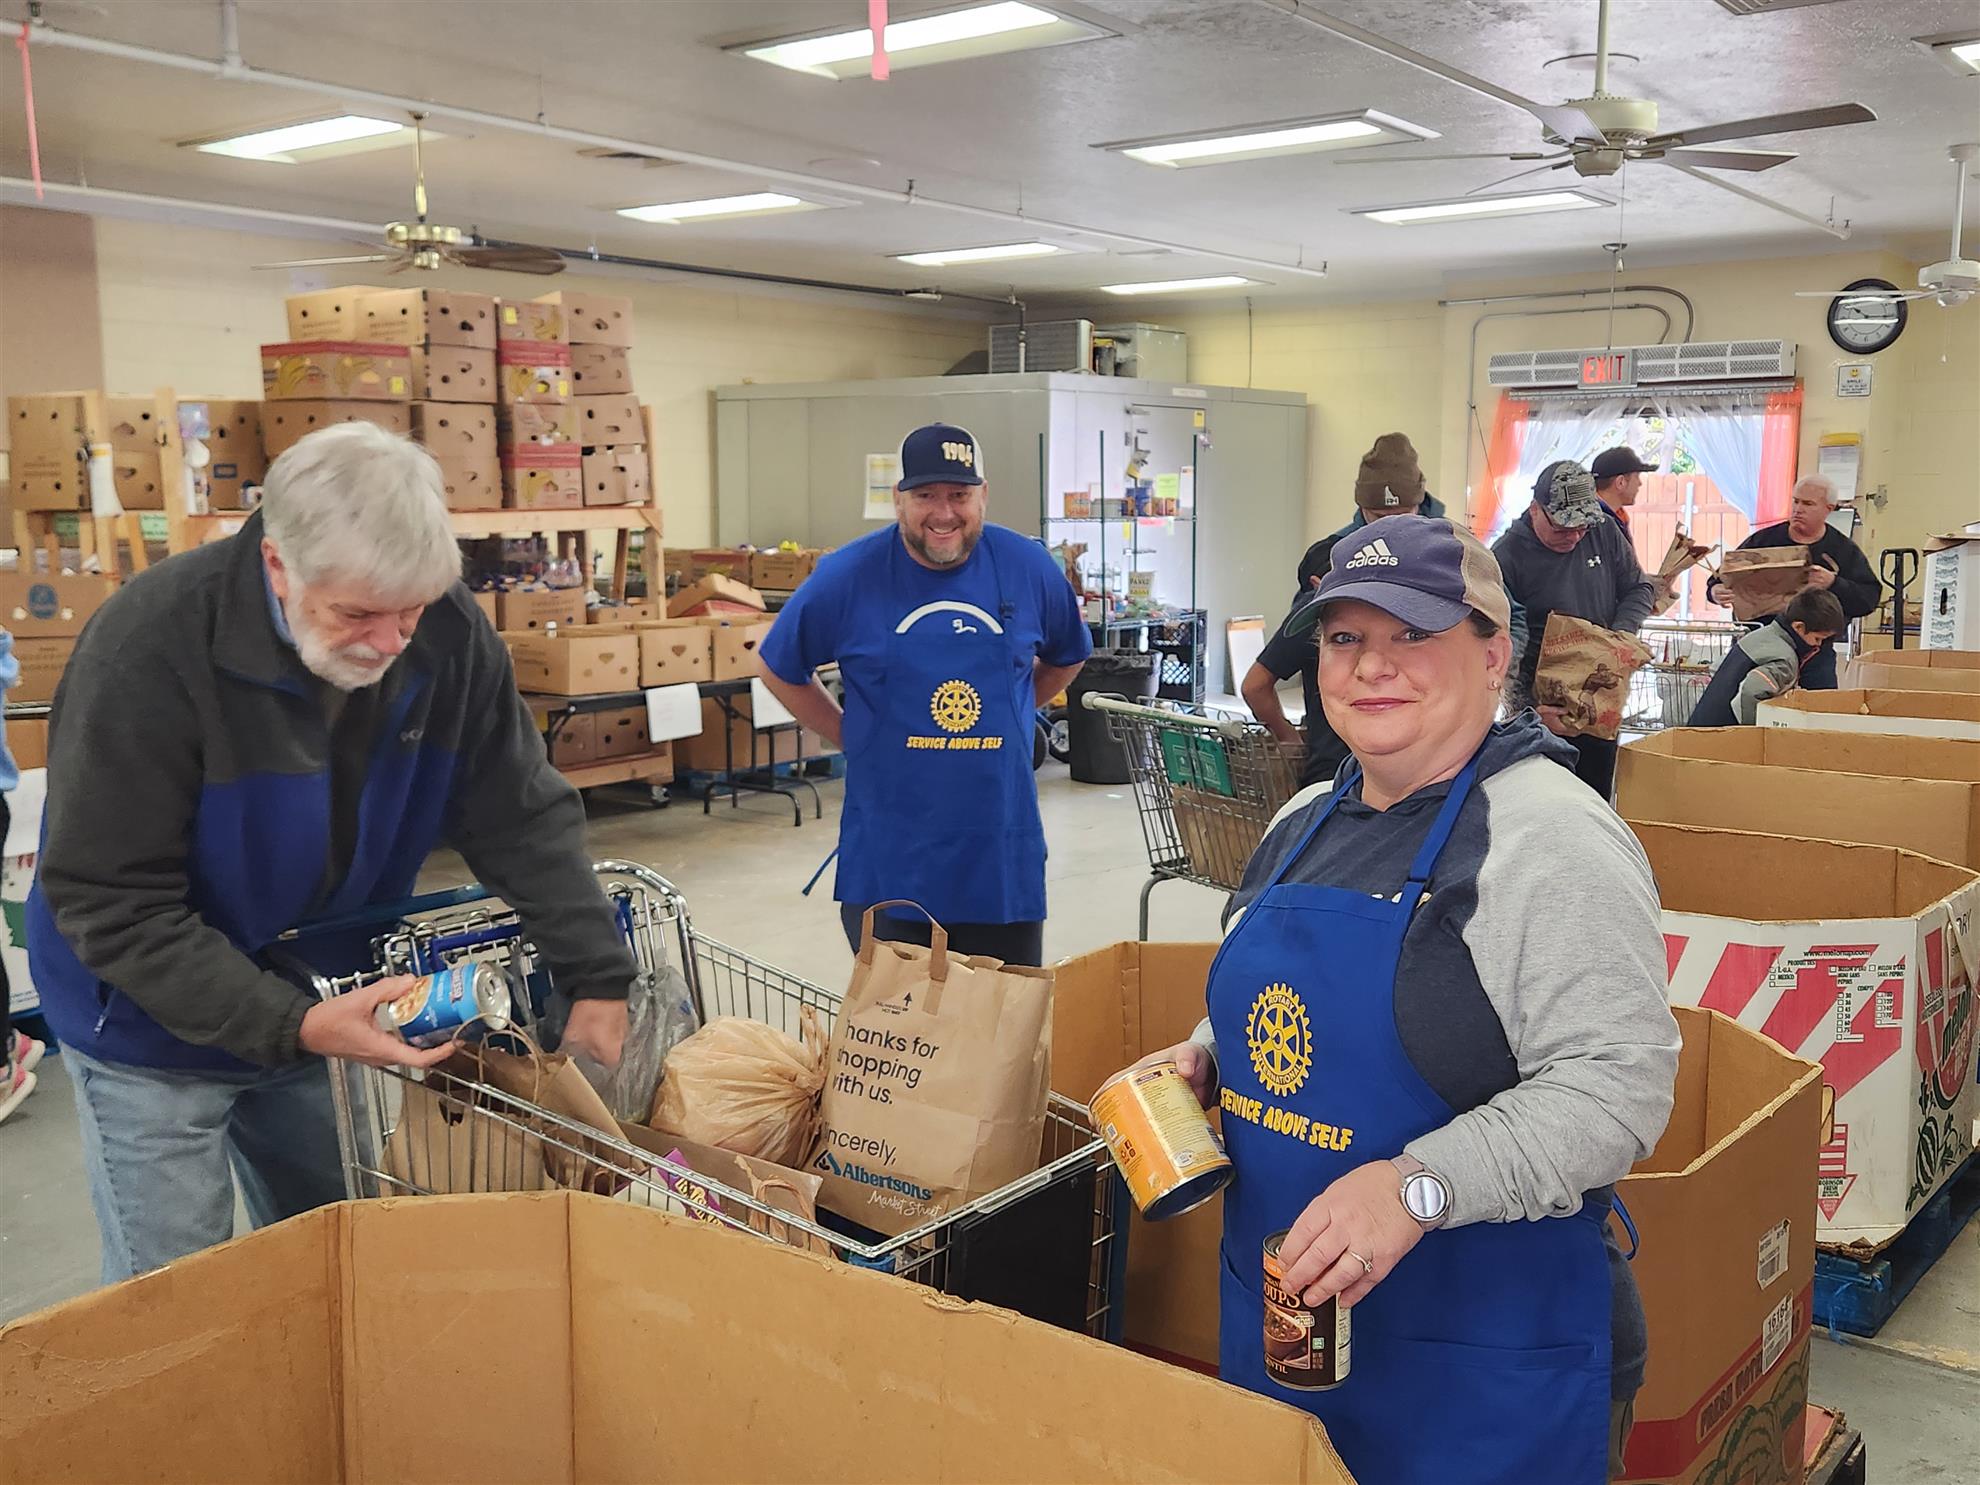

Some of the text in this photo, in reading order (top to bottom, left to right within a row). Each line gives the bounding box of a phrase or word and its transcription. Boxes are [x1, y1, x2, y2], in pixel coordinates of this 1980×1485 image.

[1583, 354, 1625, 384] EXIT
[1345, 555, 1399, 569] adidas
[906, 736, 1003, 749] SERVICE ABOVE SELF
[1267, 994, 1295, 1011] ROTARY
[845, 1019, 939, 1059] hanks for
[869, 1085, 893, 1104] us.
[1263, 1105, 1310, 1141] ABOVE
[1309, 1122, 1353, 1152] SELF
[843, 1162, 932, 1200] Albertsons
[867, 1190, 942, 1217] Market Street
[1264, 1283, 1300, 1309] OUPS
[1265, 1356, 1288, 1374] ENTIL
